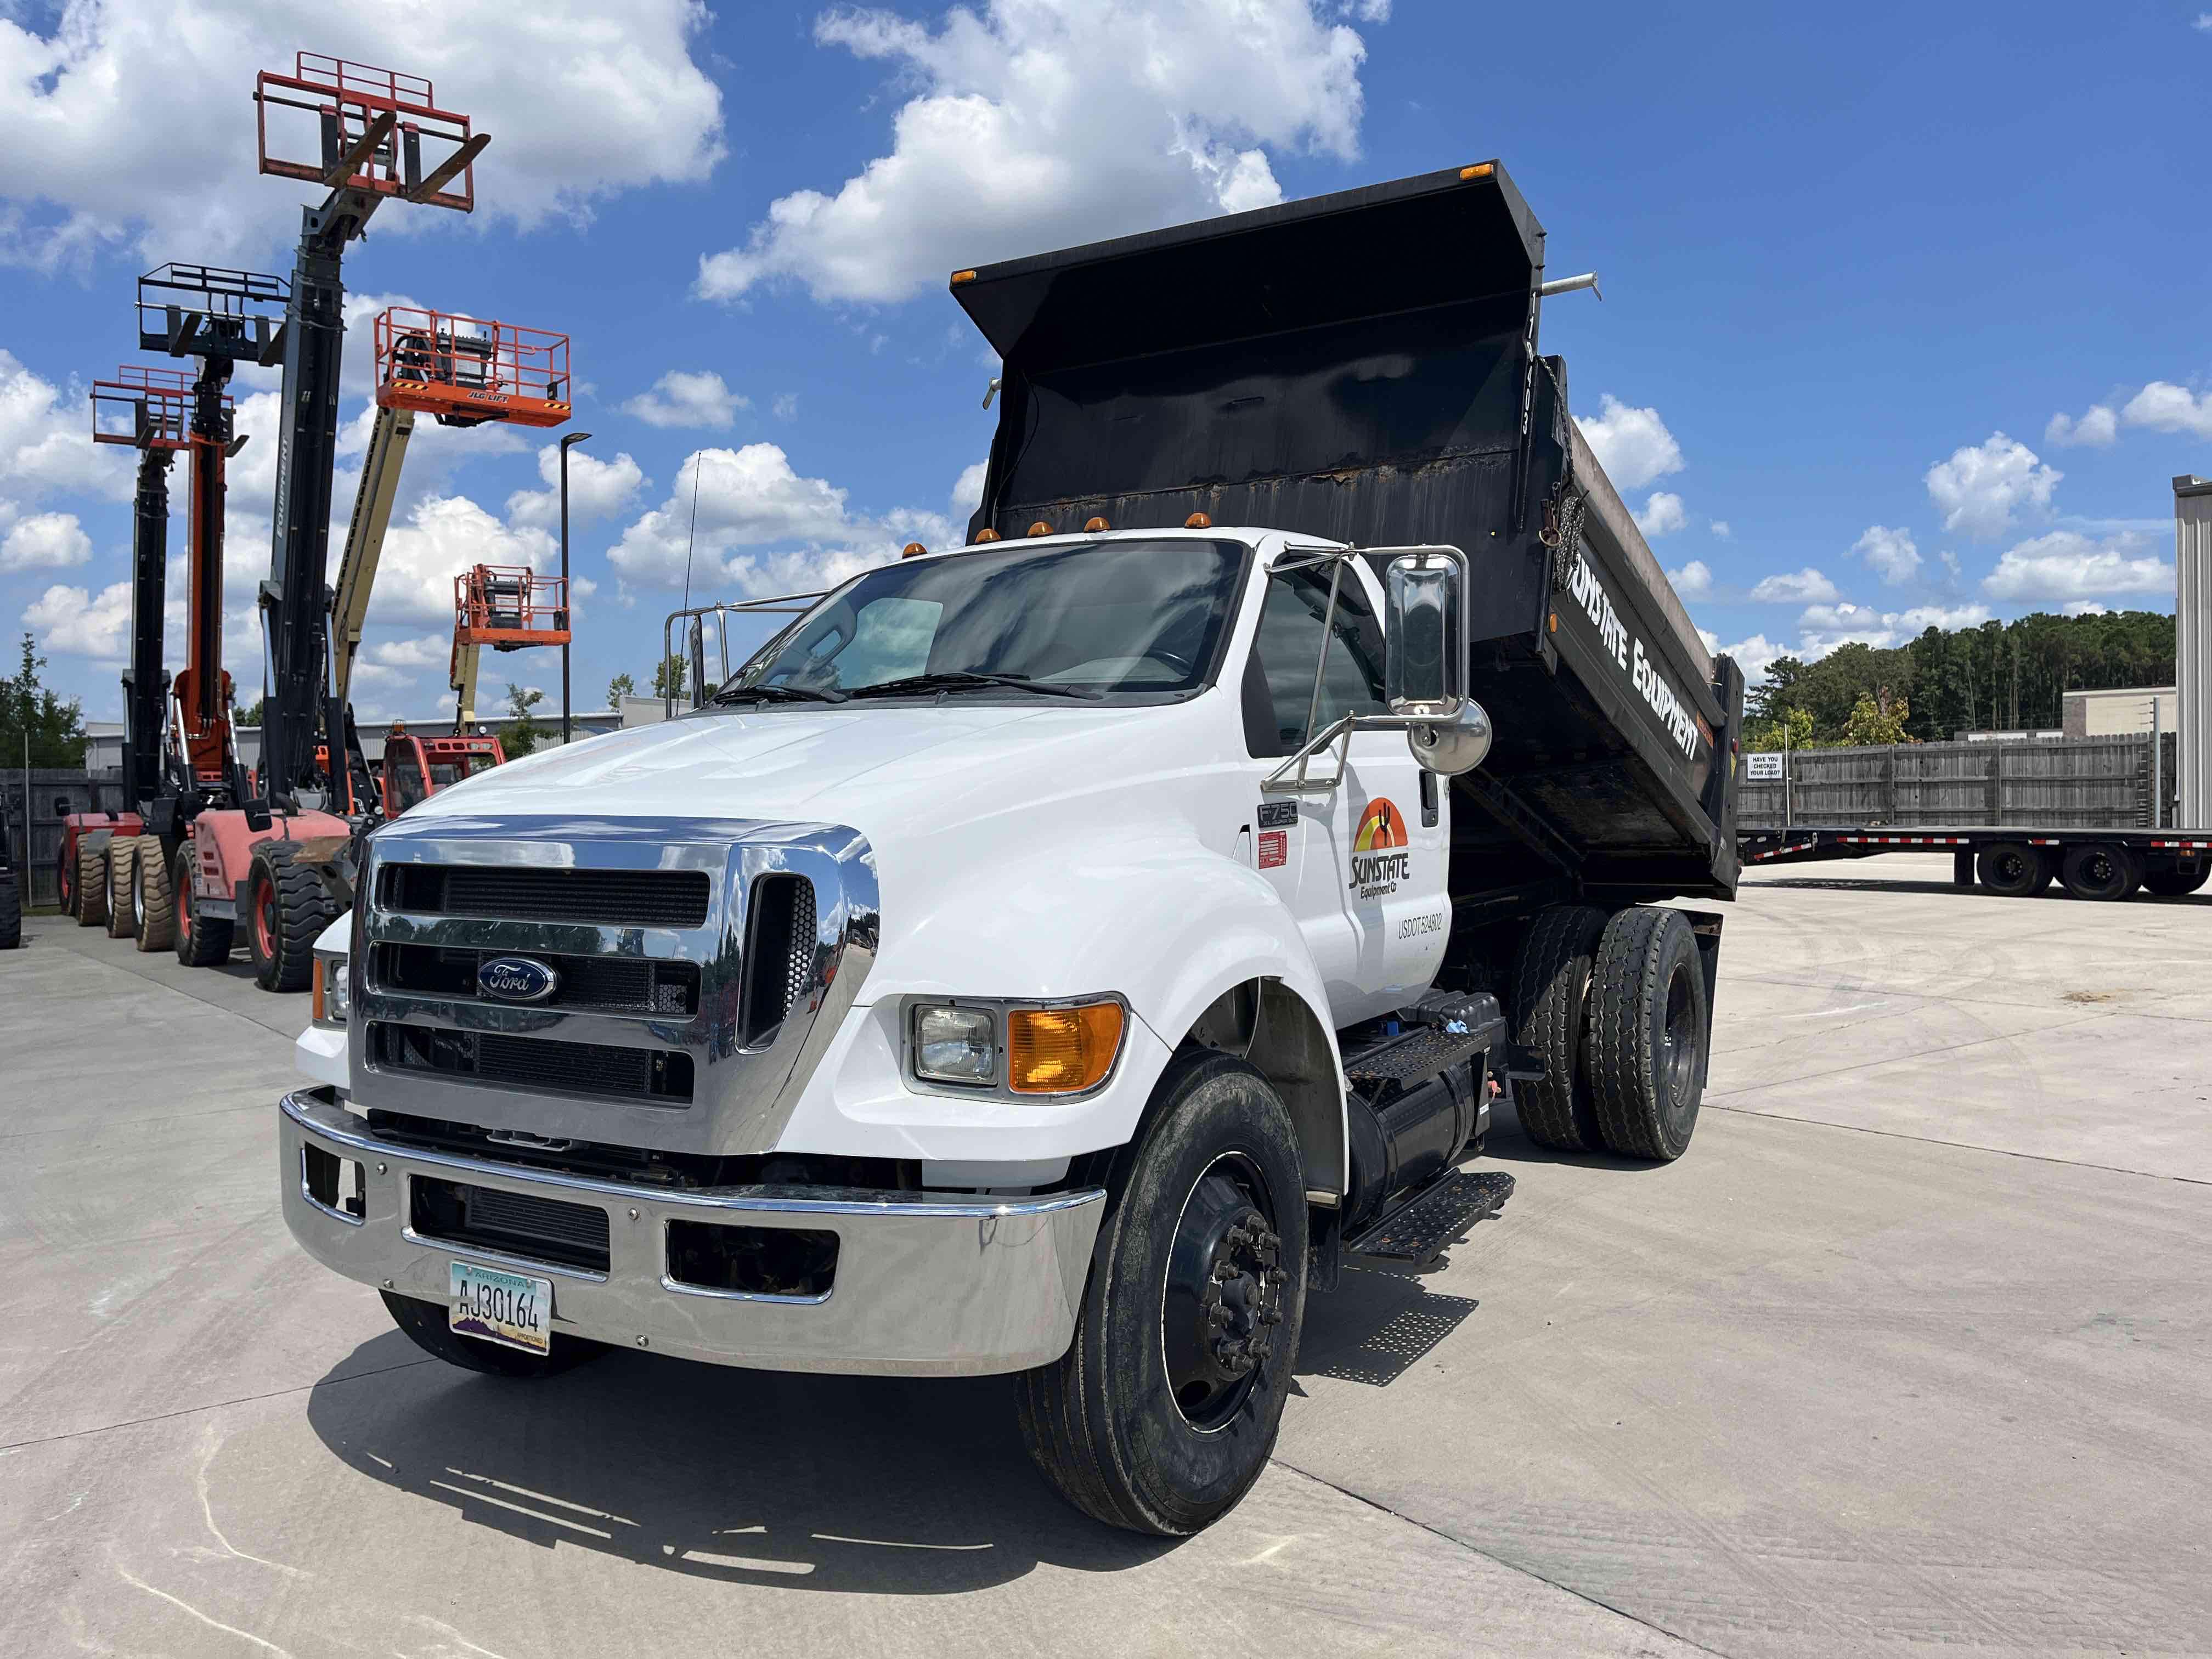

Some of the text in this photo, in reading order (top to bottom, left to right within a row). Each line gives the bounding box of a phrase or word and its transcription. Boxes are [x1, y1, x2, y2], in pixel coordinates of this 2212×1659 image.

[487, 394, 509, 403] LIFT
[276, 435, 289, 539] EQUIPMENT
[1632, 637, 1699, 761] EQUIPMENT
[1260, 803, 1298, 821] F750
[1348, 853, 1410, 889] SUNSTATE
[1361, 882, 1397, 901] Equipment Co
[1398, 912, 1442, 940] USDOT 524802
[489, 964, 531, 991] Ford
[475, 1272, 525, 1288] ARIZONA
[460, 1279, 538, 1332] AJ30164
[517, 1333, 543, 1344] APPORTIONED
